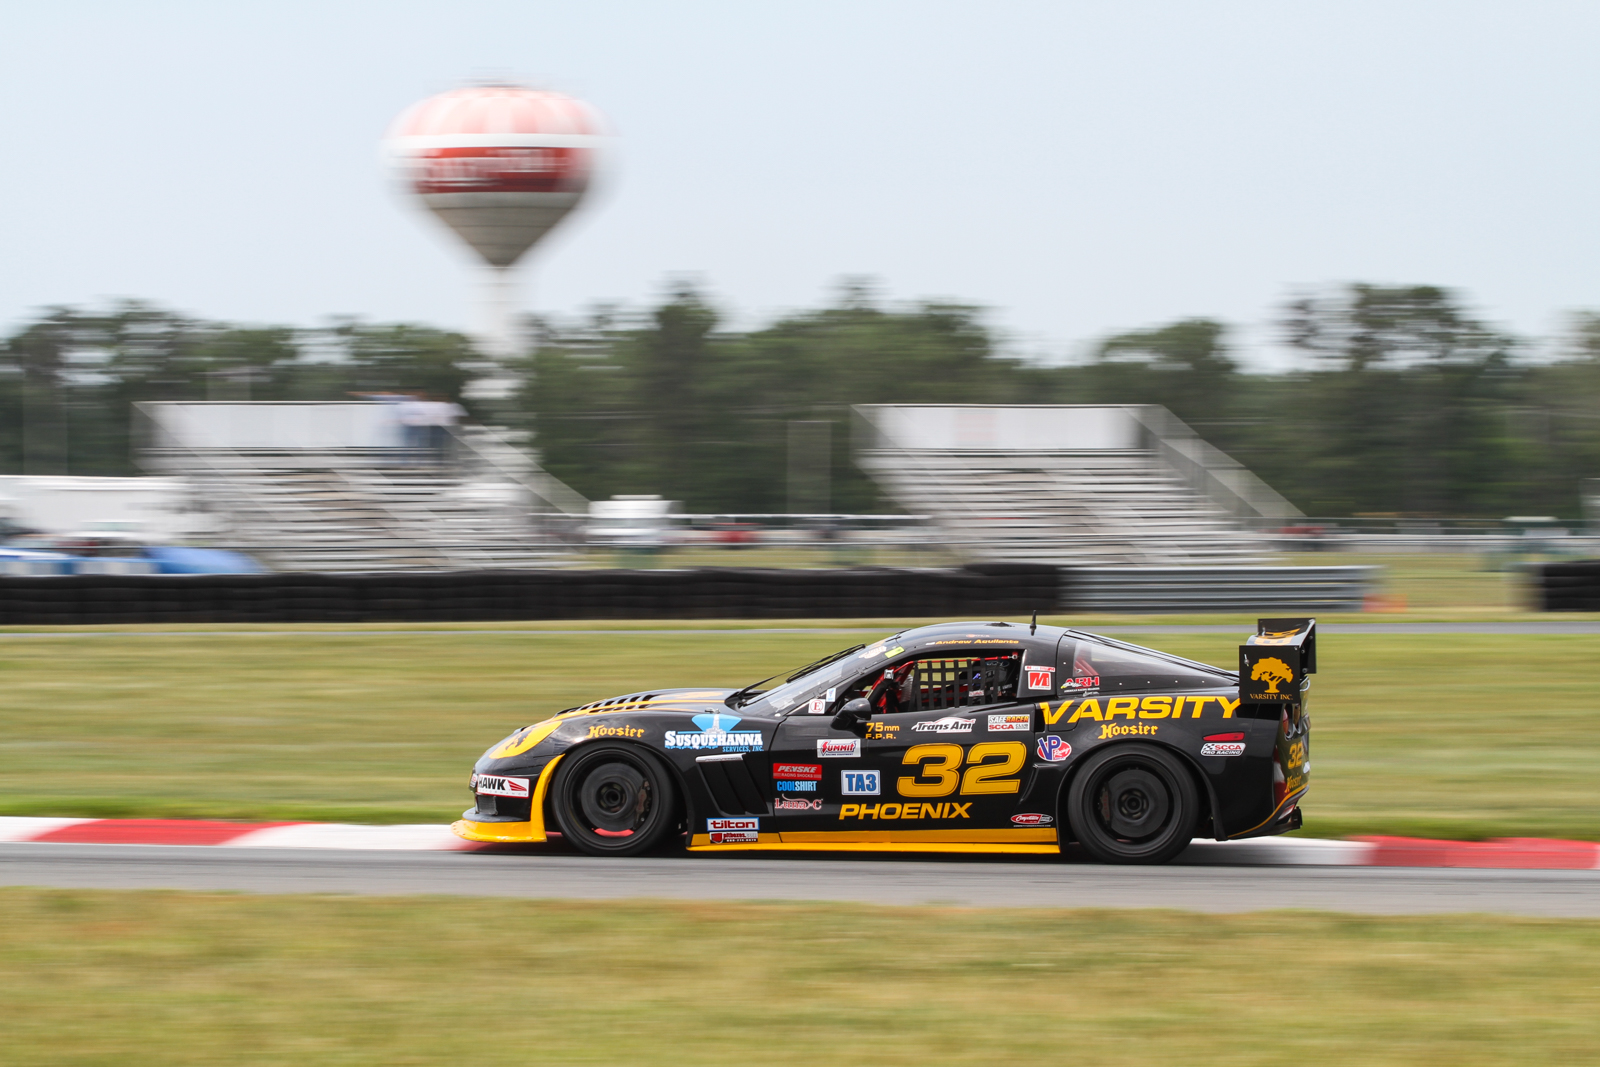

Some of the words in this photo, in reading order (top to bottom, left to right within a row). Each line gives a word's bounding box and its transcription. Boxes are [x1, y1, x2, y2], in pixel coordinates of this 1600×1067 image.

[1039, 696, 1241, 725] VARSITY
[585, 724, 645, 739] Hoosier
[917, 722, 950, 731] Trans
[950, 721, 972, 730] Am
[1097, 721, 1159, 740] Hoosier
[664, 731, 763, 749] SUSQUEHANNA
[1038, 735, 1062, 761] VP
[777, 765, 818, 773] PENSKE
[897, 741, 1027, 797] 32
[478, 776, 507, 791] HAWK
[845, 774, 877, 791] TA3
[838, 802, 973, 820] PHOENIX
[710, 820, 756, 829] tilton
